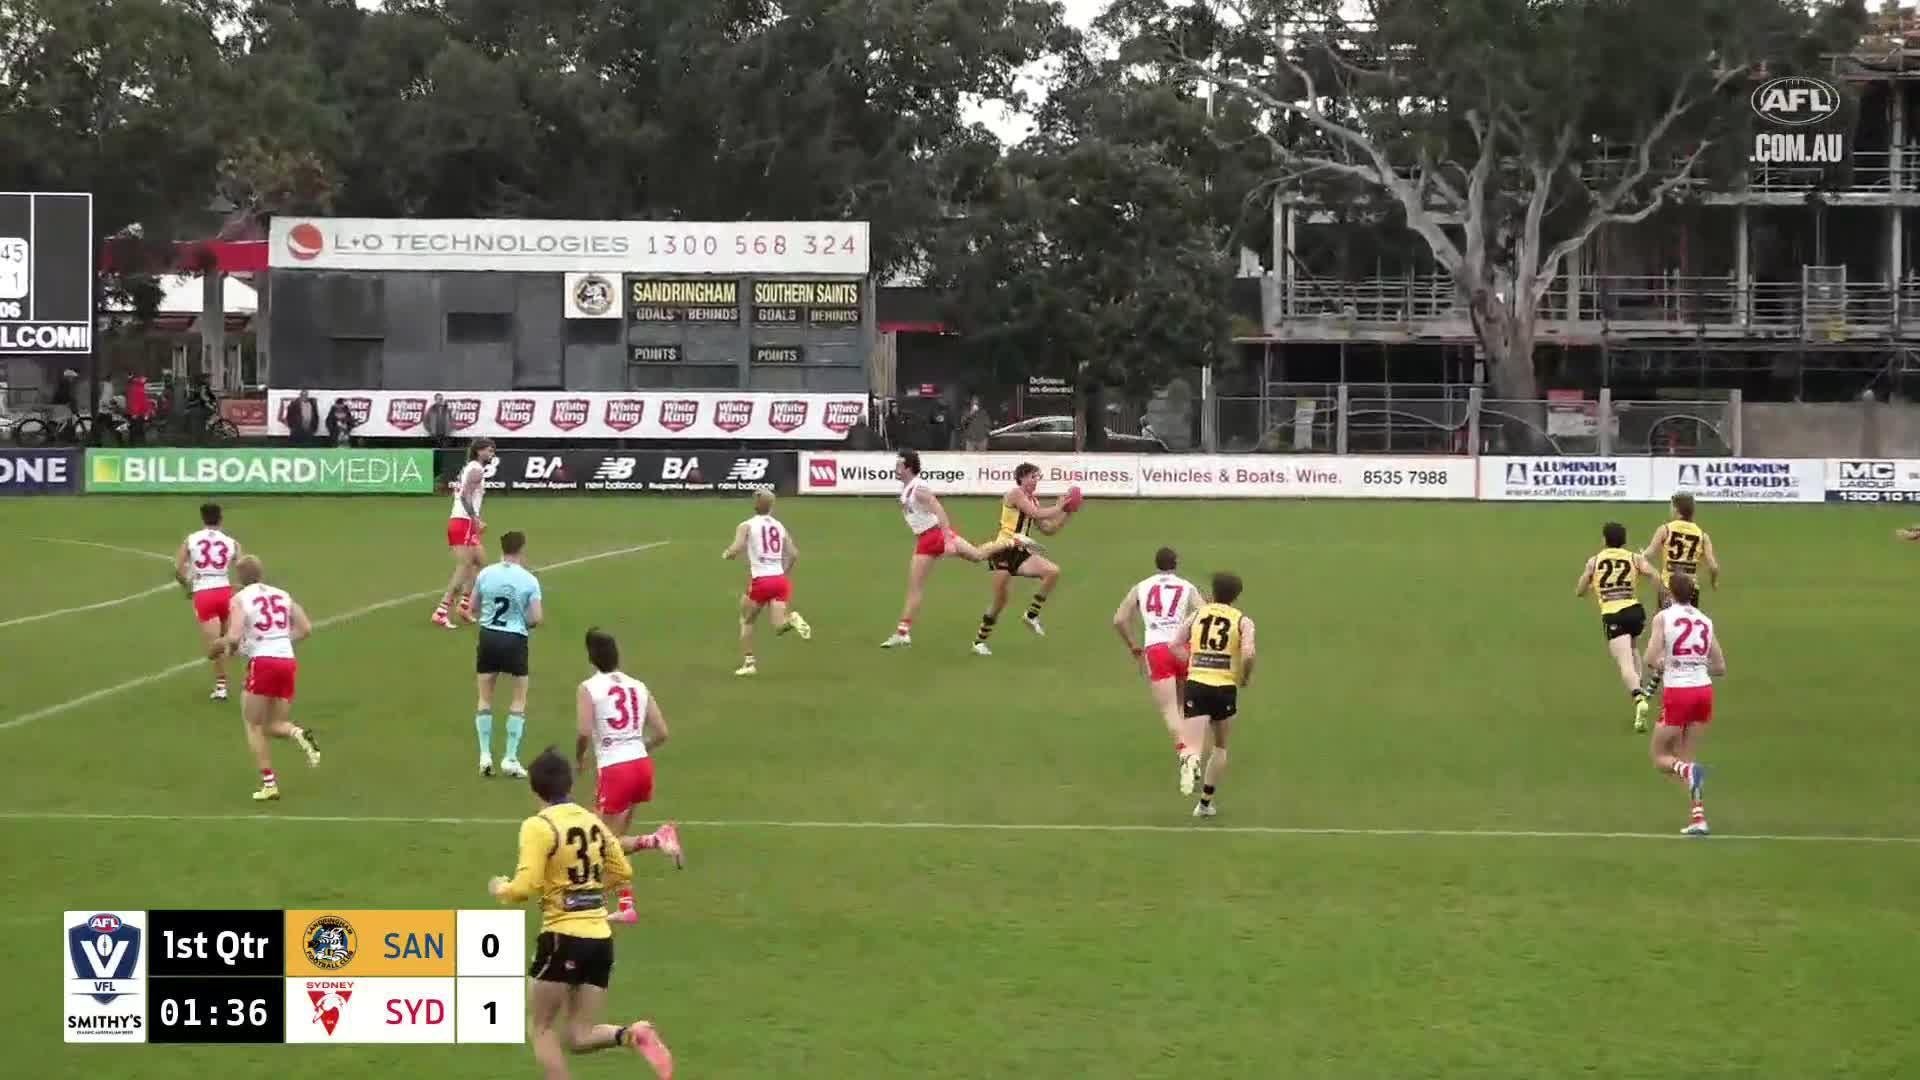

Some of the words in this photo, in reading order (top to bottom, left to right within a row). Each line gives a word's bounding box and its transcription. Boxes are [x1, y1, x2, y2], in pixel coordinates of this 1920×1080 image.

[392, 234, 630, 253] TECHNOLOGIES
[648, 235, 718, 255] 1300
[735, 235, 787, 255] 568
[803, 235, 857, 255] 324
[633, 282, 737, 303] SANDRINGHAM
[755, 283, 814, 303] SOUTHERN
[816, 283, 858, 304] SAINTS
[636, 307, 675, 321] GOALS
[688, 307, 738, 321] BEHINDS
[758, 308, 797, 321] GOALS
[810, 309, 859, 322] BEHINDS
[635, 348, 677, 361] POINTS
[758, 349, 798, 362] POINTS
[392, 401, 424, 410] White
[502, 402, 533, 410] White
[556, 402, 587, 411] White
[610, 402, 641, 411] White
[664, 403, 696, 412] White
[719, 403, 750, 412] White
[774, 403, 805, 412] White
[829, 404, 859, 413] White
[391, 410, 422, 424] King
[501, 411, 531, 424] King
[555, 411, 585, 424] King
[609, 411, 640, 424] King
[663, 411, 695, 425] King
[719, 412, 748, 425] King
[773, 412, 803, 425] King
[828, 413, 858, 426] King
[1533, 461, 1617, 473] ALUMINIUM
[1705, 463, 1790, 474] ALUMINIUM
[1840, 462, 1895, 480] MC
[919, 468, 965, 483] orage
[978, 467, 1016, 481] Hom
[1051, 467, 1134, 482] Business.
[1142, 468, 1212, 484] Vehicles
[1218, 469, 1230, 484] &
[1236, 469, 1290, 484] Boats.
[1296, 469, 1343, 484] Wine.
[1363, 470, 1403, 485] 8535
[1408, 470, 1448, 485] 7988
[1533, 475, 1617, 486] SCAFFOLDS
[1705, 476, 1791, 488] SCAFFOLDS
[1840, 480, 1895, 489] LABOUR
[1840, 491, 1880, 502] 1300
[761, 525, 781, 553] 18
[1669, 531, 1700, 561] 57
[195, 539, 229, 570] 33
[1598, 559, 1632, 588] 22
[1145, 584, 1185, 617] 47
[252, 594, 288, 632] 35
[491, 596, 510, 627] 2
[1199, 613, 1232, 651] 13
[1672, 617, 1710, 657] 23
[607, 686, 639, 730] 31
[566, 824, 606, 884] 33
